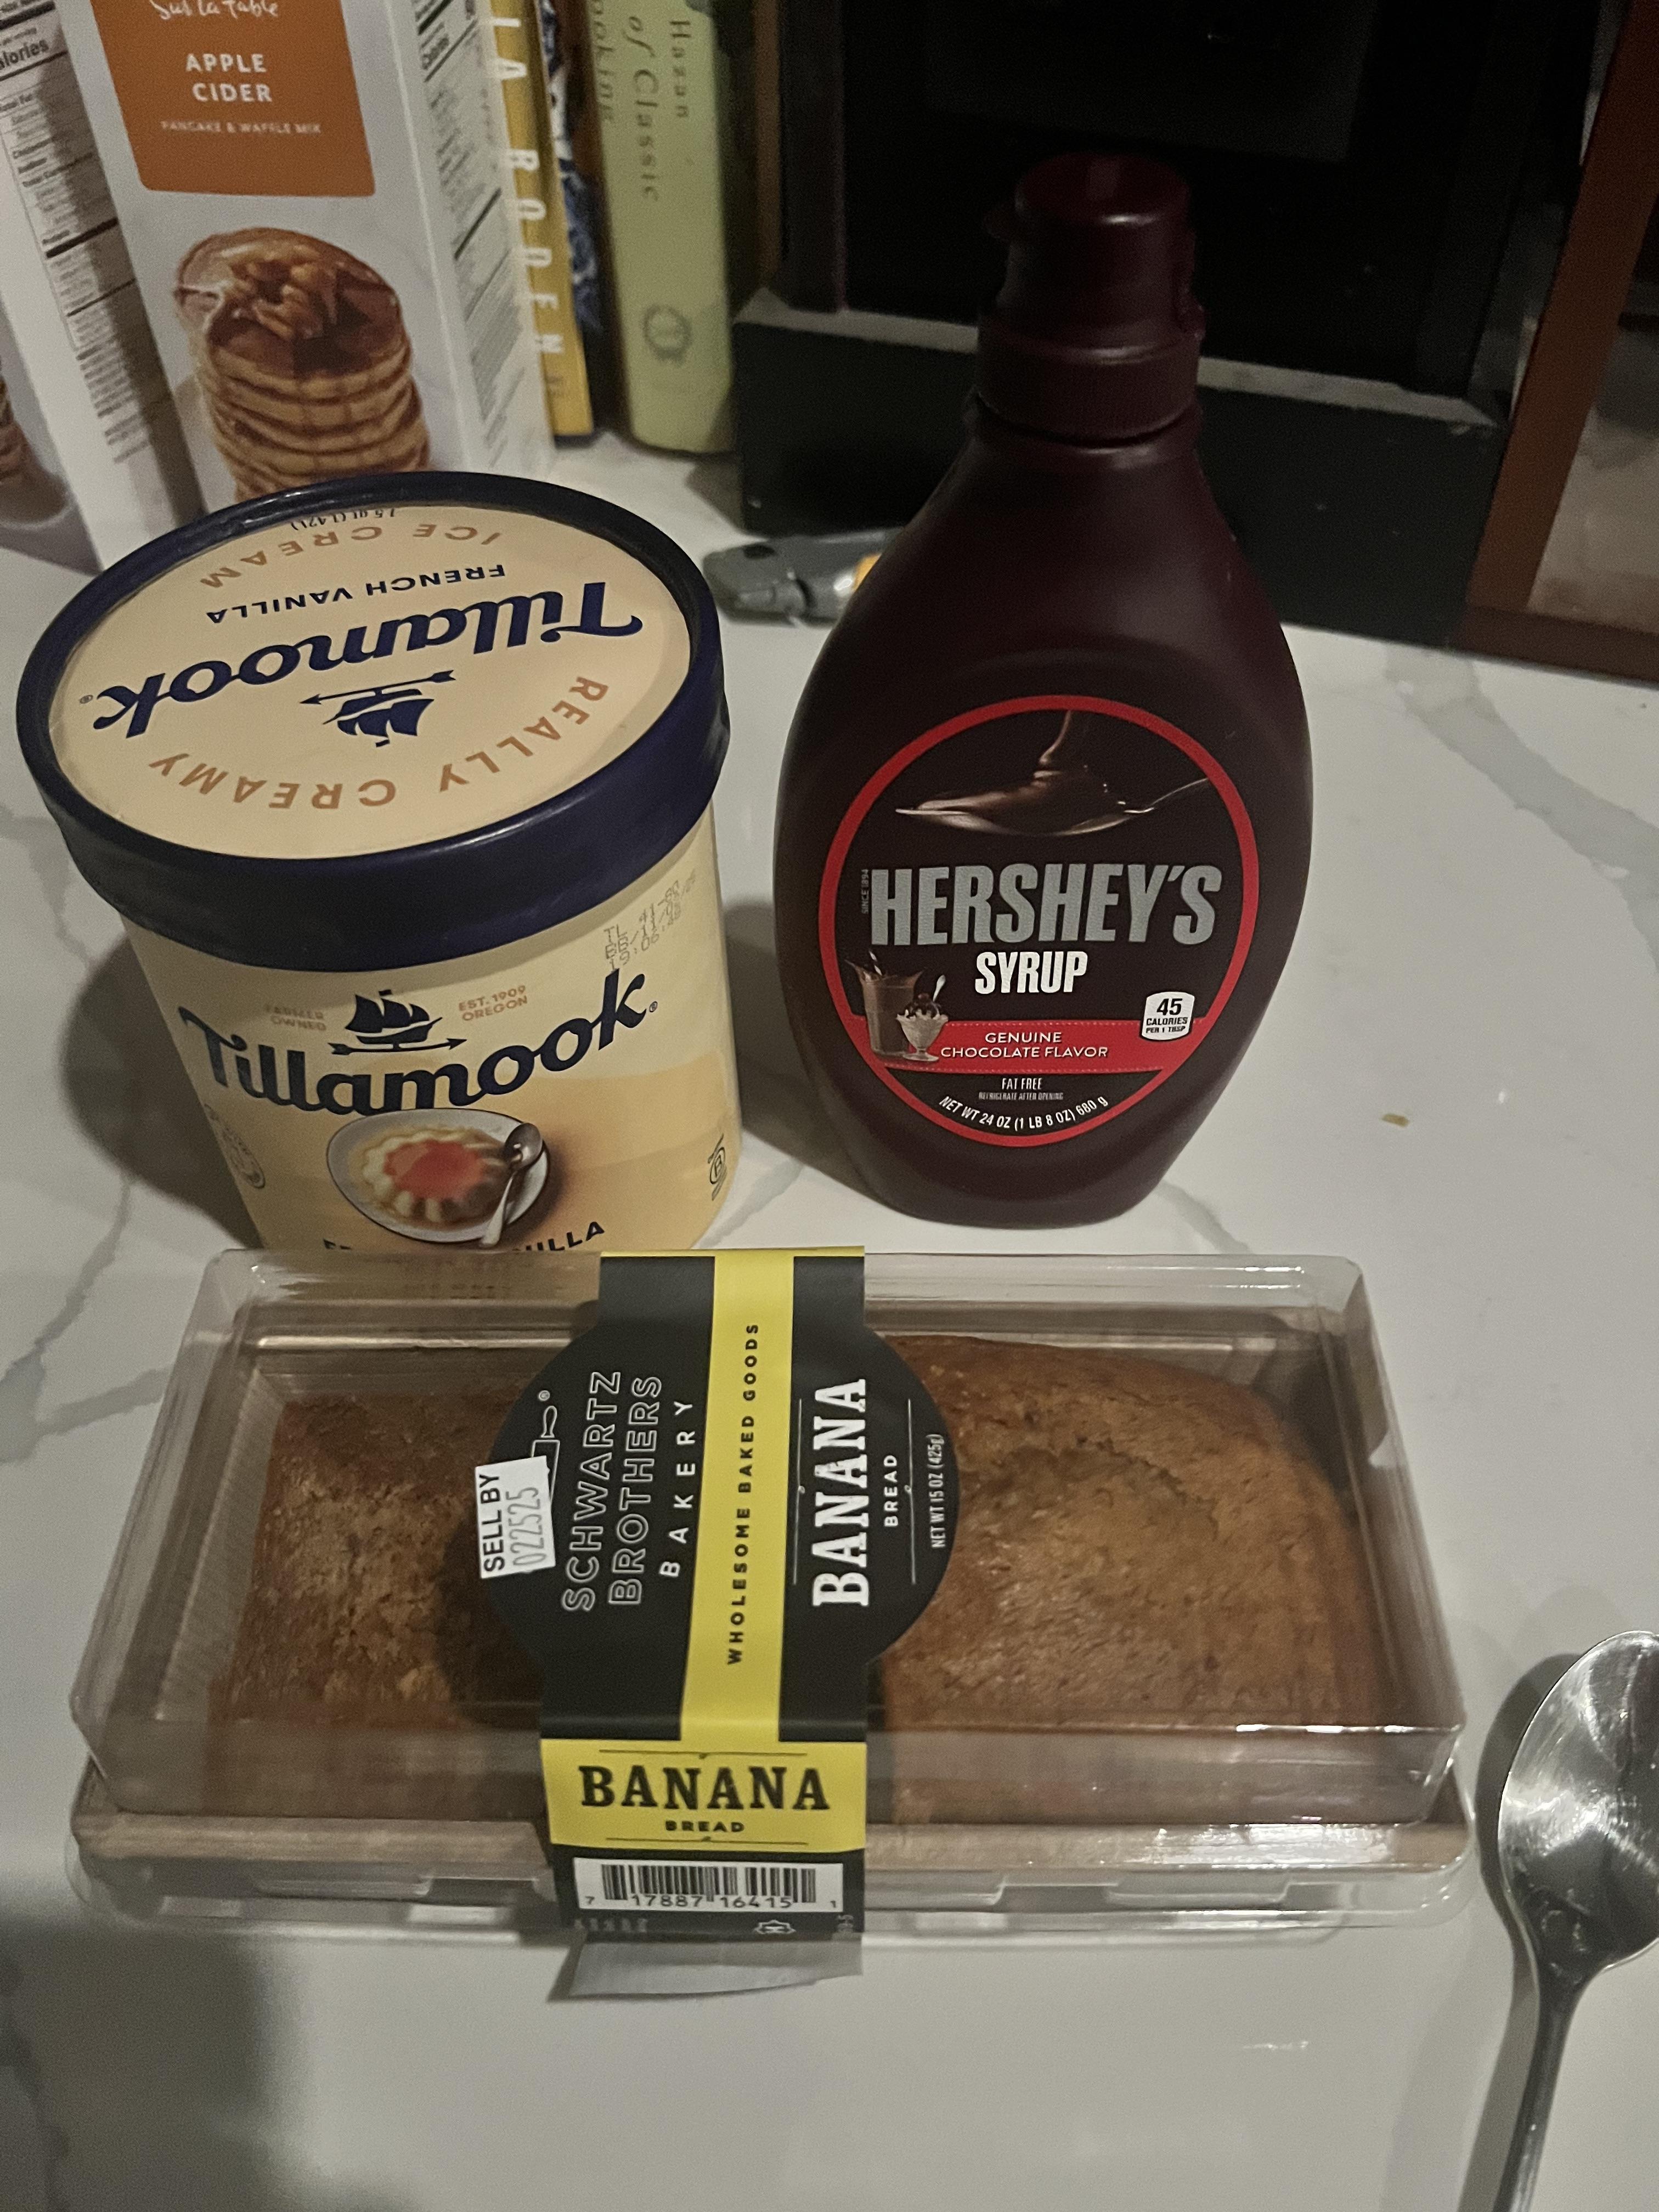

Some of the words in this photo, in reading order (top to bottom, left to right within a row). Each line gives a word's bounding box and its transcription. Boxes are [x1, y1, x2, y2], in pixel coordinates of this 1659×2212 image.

[622, 16, 656, 58] of
[185, 53, 267, 73] APPLE
[192, 83, 272, 102] CIDER
[633, 69, 660, 202] Classic
[413, 521, 501, 545] ICE
[200, 526, 383, 588] CREAM
[366, 563, 506, 596] FRENCH
[206, 588, 353, 623] VANILLA
[93, 582, 643, 738] Tillamook
[439, 676, 609, 793] REALLY
[148, 753, 397, 810] CREAMY
[871, 863, 1222, 945] HERSHEY'S
[975, 951, 1088, 995] SYRUP
[459, 996, 490, 1011] EST.
[491, 985, 526, 1002] 1909
[462, 995, 528, 1021] OREGON
[1156, 998, 1183, 1016] 45
[985, 1032, 1062, 1043] GENUINE
[1146, 1017, 1188, 1026] CALORIES
[178, 968, 647, 1116] Tillamook
[940, 1047, 1040, 1058] CHOCOLATE
[1045, 1047, 1108, 1058] FLAVOR
[978, 1092, 1017, 1101] REFRIGERATE
[1018, 1092, 1036, 1101] AFTER
[1038, 1092, 1063, 1101] OPENING
[1002, 1078, 1019, 1090] FAT
[1021, 1077, 1043, 1090] FREE
[939, 1096, 963, 1113] NET
[961, 1106, 980, 1121] WT
[979, 1113, 994, 1126] 24
[996, 1116, 1011, 1128] OZ
[1014, 1118, 1024, 1132] (1
[1029, 1116, 1042, 1129] LB
[1046, 1114, 1053, 1126] 8
[1055, 1109, 1076, 1122] OZ)
[1075, 1099, 1097, 1116] 680
[1097, 1096, 1109, 1107] g
[742, 1324, 759, 1402] GOODS
[737, 1415, 755, 1493] BAKED
[926, 1434, 945, 1469] (425g)
[479, 1474, 501, 1504] BY
[561, 1371, 621, 1612] SCHWARTZ
[608, 1376, 662, 1606] BROTHERS
[660, 1401, 695, 1578] BAKERY
[811, 1379, 870, 1607] BANANA
[883, 1454, 899, 1527] BREAD
[928, 1472, 944, 1488] OZ
[929, 1491, 945, 1503] 15
[506, 1487, 547, 1567] 022525
[929, 1505, 945, 1523] WT
[482, 1510, 505, 1572] SELL
[930, 1526, 946, 1549] NET
[726, 1508, 751, 1665] WHOLESOME
[578, 1764, 830, 1810] BANANA
[664, 1820, 745, 1832] BREAD
[584, 1895, 595, 1905] 7
[631, 1894, 703, 1908] 17887
[719, 1895, 793, 1909] 16415
[830, 1900, 837, 1909] 1
